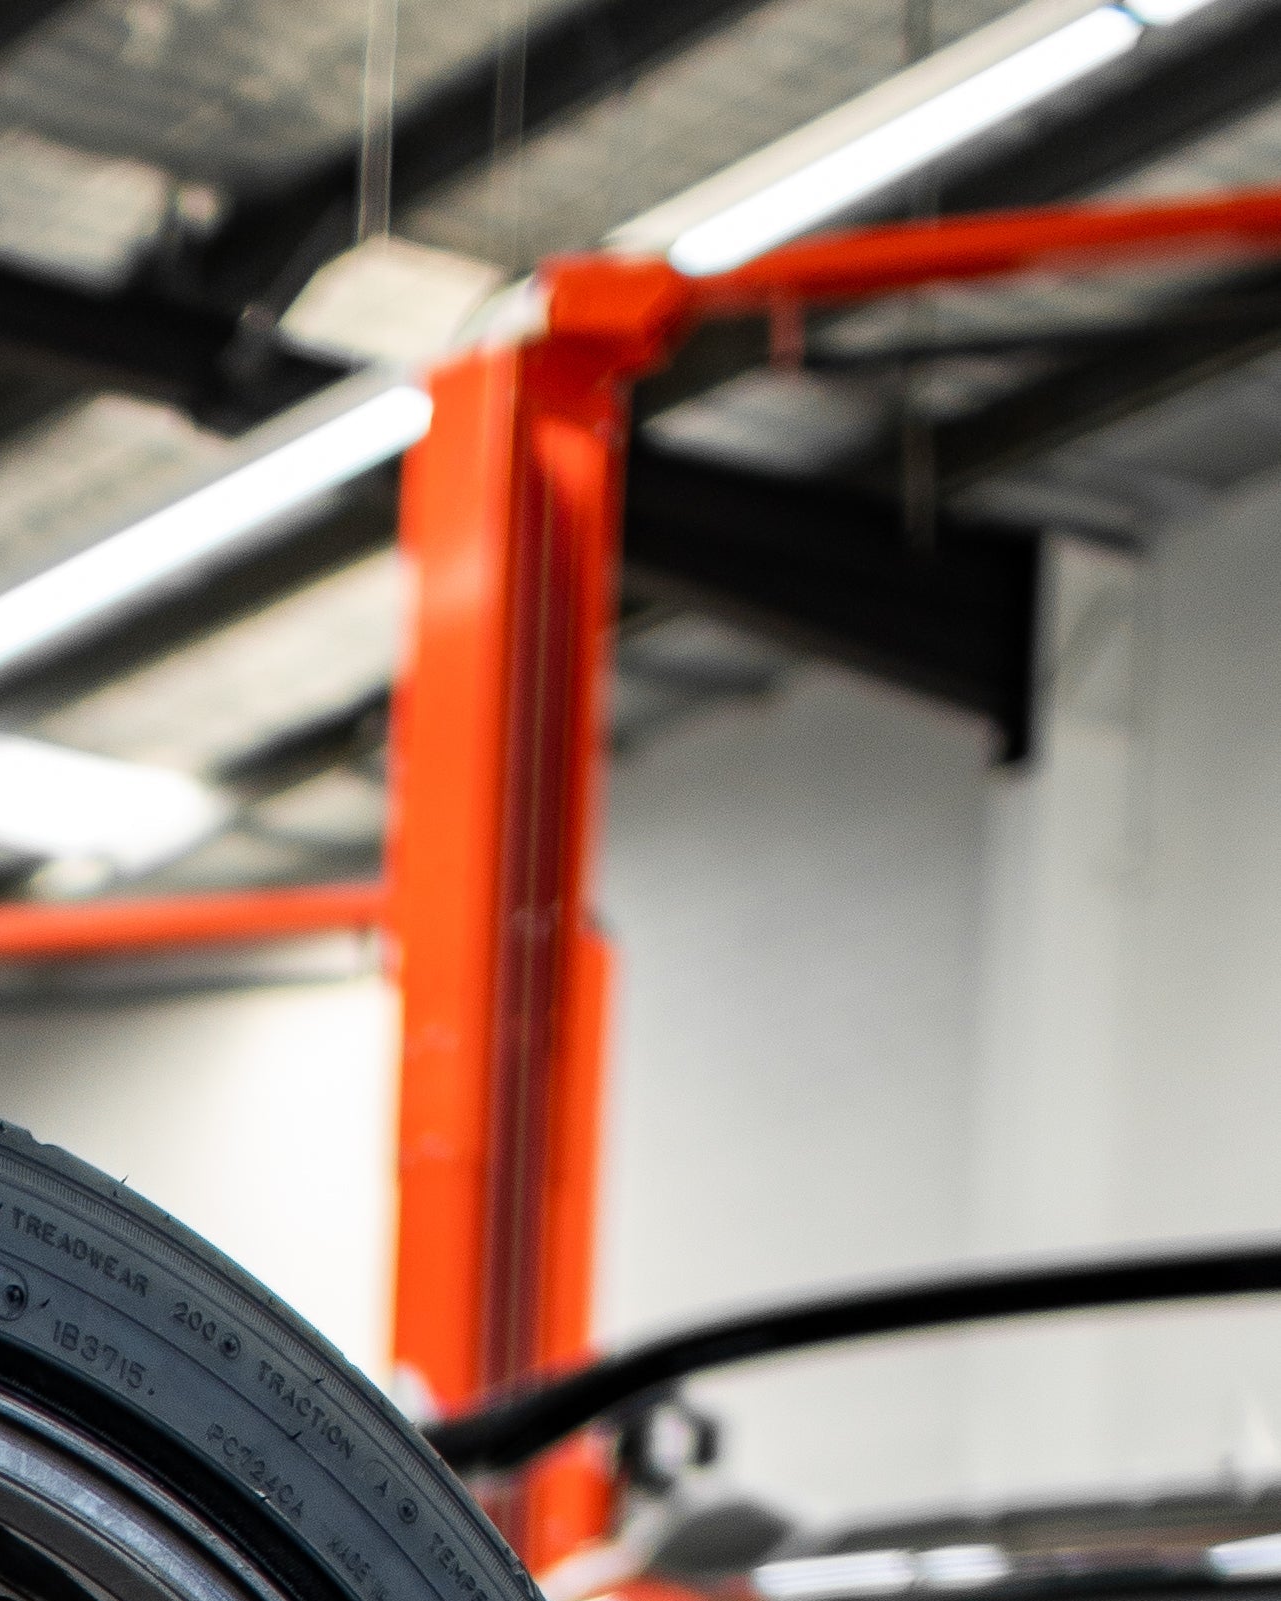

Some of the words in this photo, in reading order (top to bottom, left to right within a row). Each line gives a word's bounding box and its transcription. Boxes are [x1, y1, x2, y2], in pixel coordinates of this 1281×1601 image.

[6, 1203, 153, 1299] TREADWEAR
[169, 1297, 220, 1345] 200
[251, 1357, 359, 1462] TRACTION
